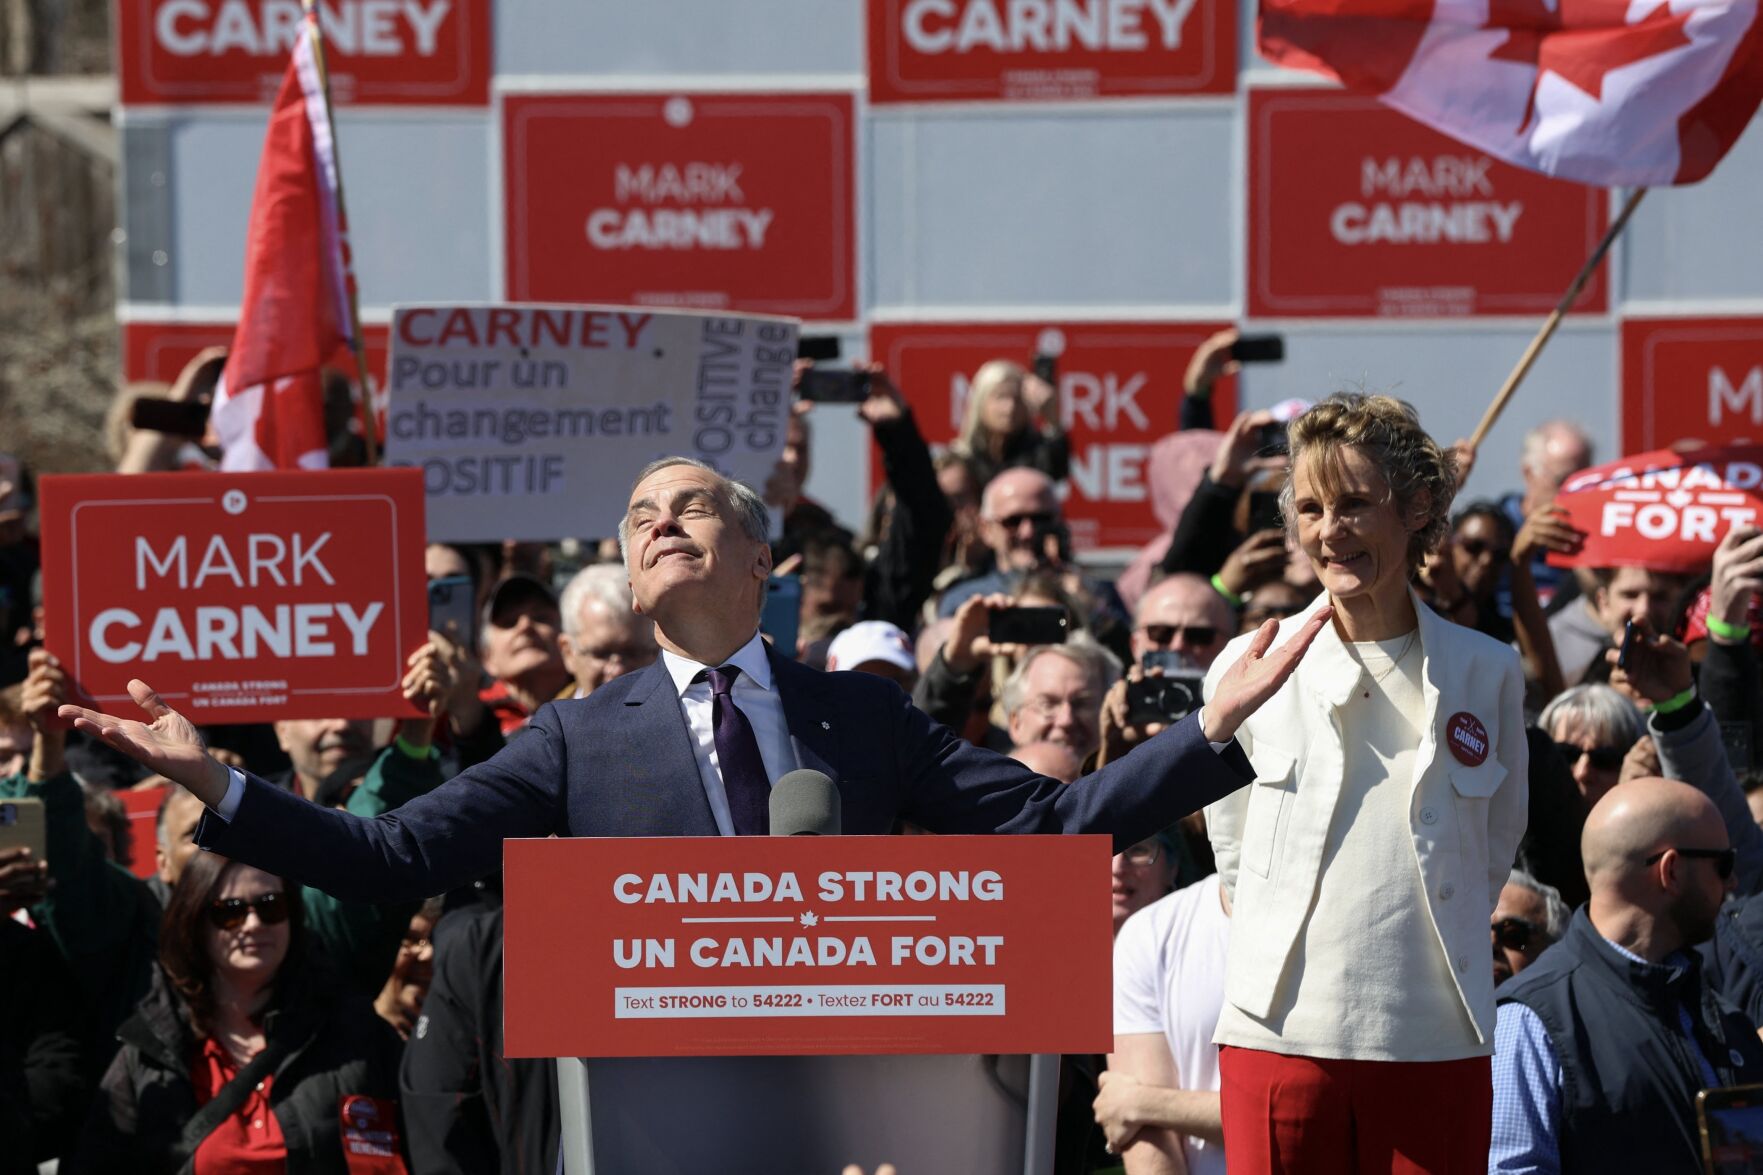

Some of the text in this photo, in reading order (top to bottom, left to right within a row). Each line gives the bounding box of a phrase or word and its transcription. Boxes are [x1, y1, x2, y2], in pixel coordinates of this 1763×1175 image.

[155, 0, 451, 56] CARNEY
[902, 0, 1196, 54] CARNEY
[613, 161, 744, 204] MARK
[1360, 155, 1493, 197] MARK
[585, 208, 773, 250] CARNEY
[1330, 201, 1523, 244] CARNEY
[400, 307, 653, 349] CARNEY
[393, 355, 568, 392] Pour un
[736, 323, 792, 449] change
[694, 318, 744, 474] OSITIVE
[392, 401, 672, 444] changement
[391, 455, 564, 494] OSITIF
[1600, 501, 1757, 543] FORT
[135, 532, 336, 590] MARK
[88, 602, 384, 664] CARNEY
[192, 680, 288, 693] CANADA STRONG
[192, 694, 288, 708] UN CANADA FORT
[1454, 725, 1485, 755] CARNEY
[613, 870, 1004, 905] CANADA STRONG
[613, 935, 1004, 969] UN CANADA FORT
[624, 992, 995, 1009] Text STRONG to 54222 Textez FORT au 54222
